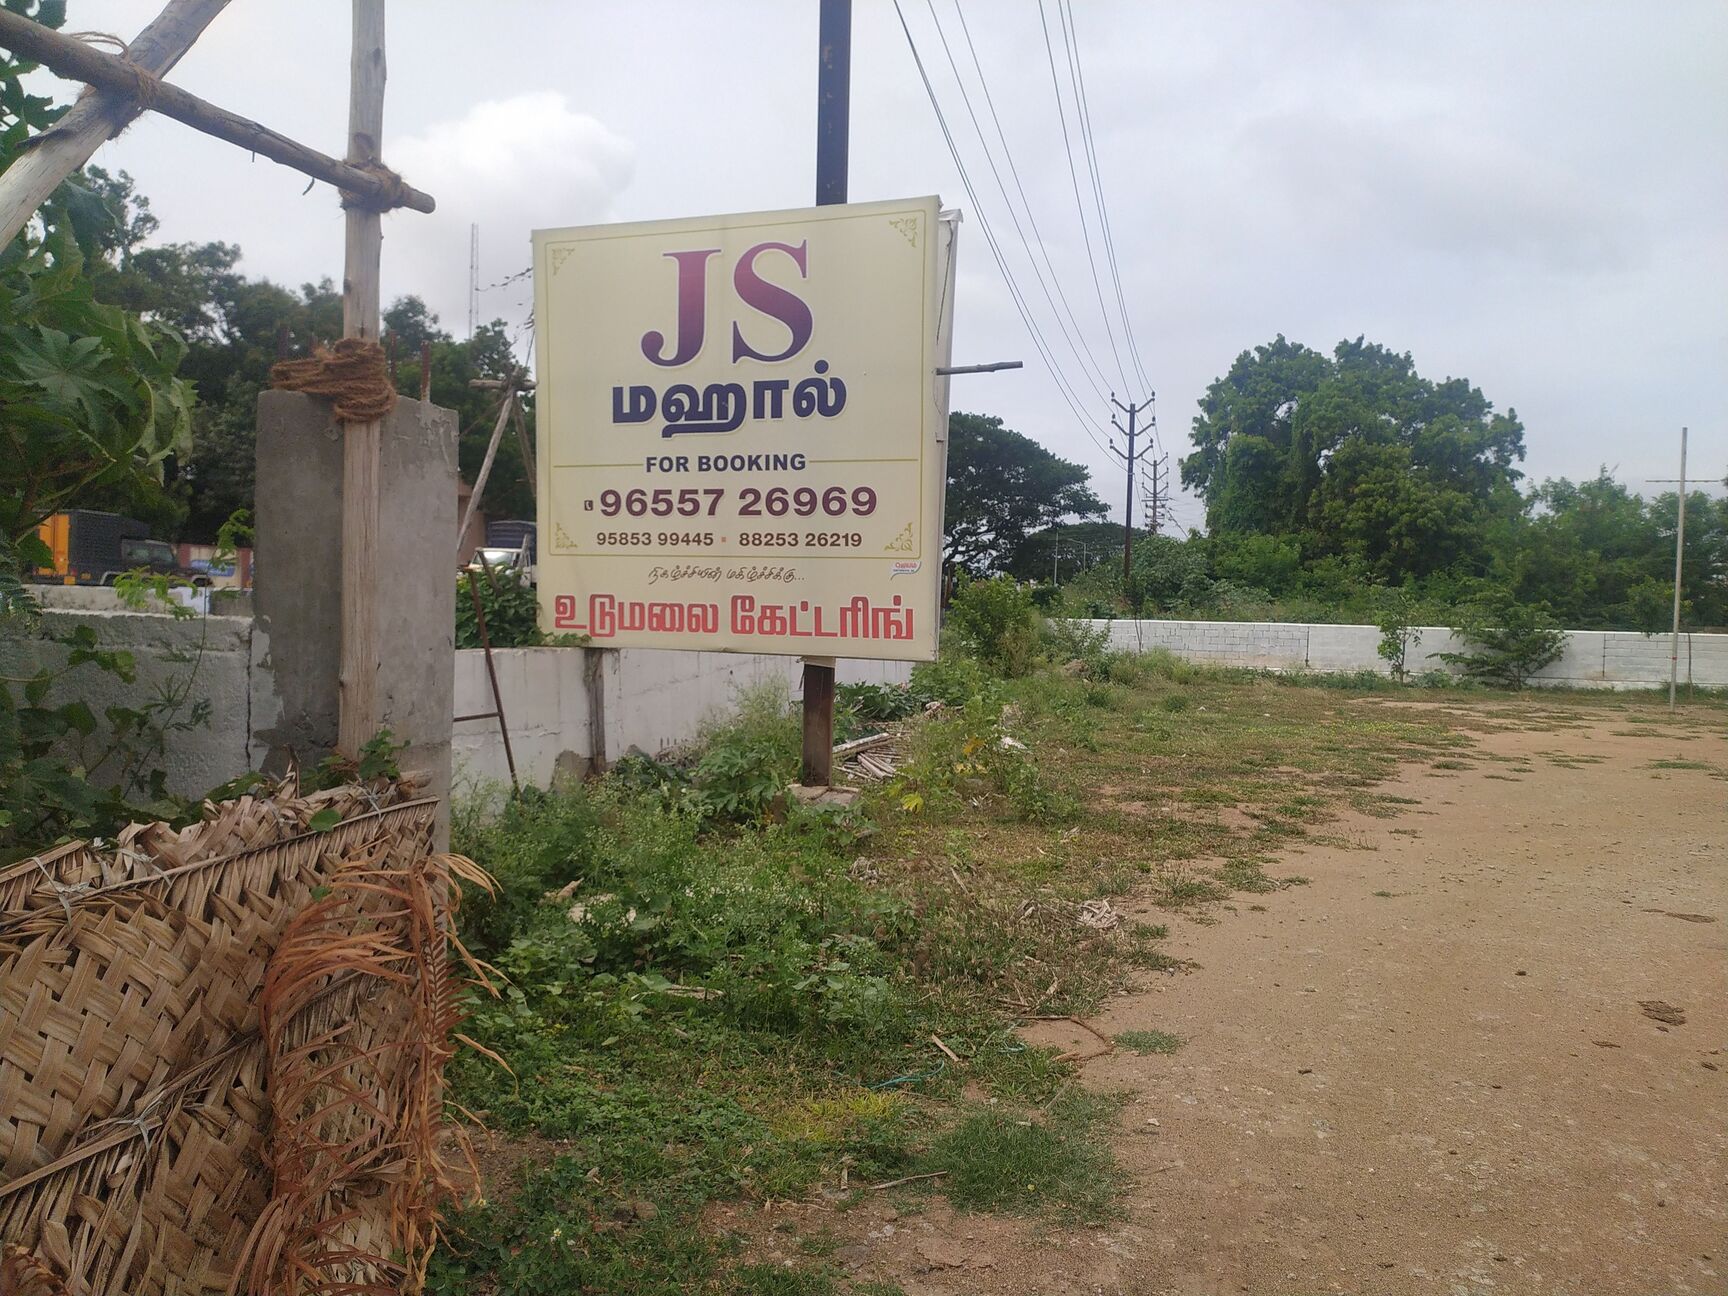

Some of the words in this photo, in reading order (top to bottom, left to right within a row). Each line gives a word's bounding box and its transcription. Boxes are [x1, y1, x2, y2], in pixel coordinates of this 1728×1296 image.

[641, 239, 814, 367] JS
[612, 359, 847, 438] மஹால்
[645, 456, 689, 473] FOR
[697, 454, 807, 473] BOOKING
[600, 488, 725, 517] 96557
[738, 487, 878, 517] 26969
[596, 532, 652, 547] 95853
[657, 532, 714, 547] 99445
[739, 532, 799, 548] 88253
[804, 532, 862, 548] 26219
[648, 564, 722, 585] நிகழ்ச்சியின்
[554, 593, 719, 639] உடுமலை
[730, 593, 915, 641] கேட்டரிங்
